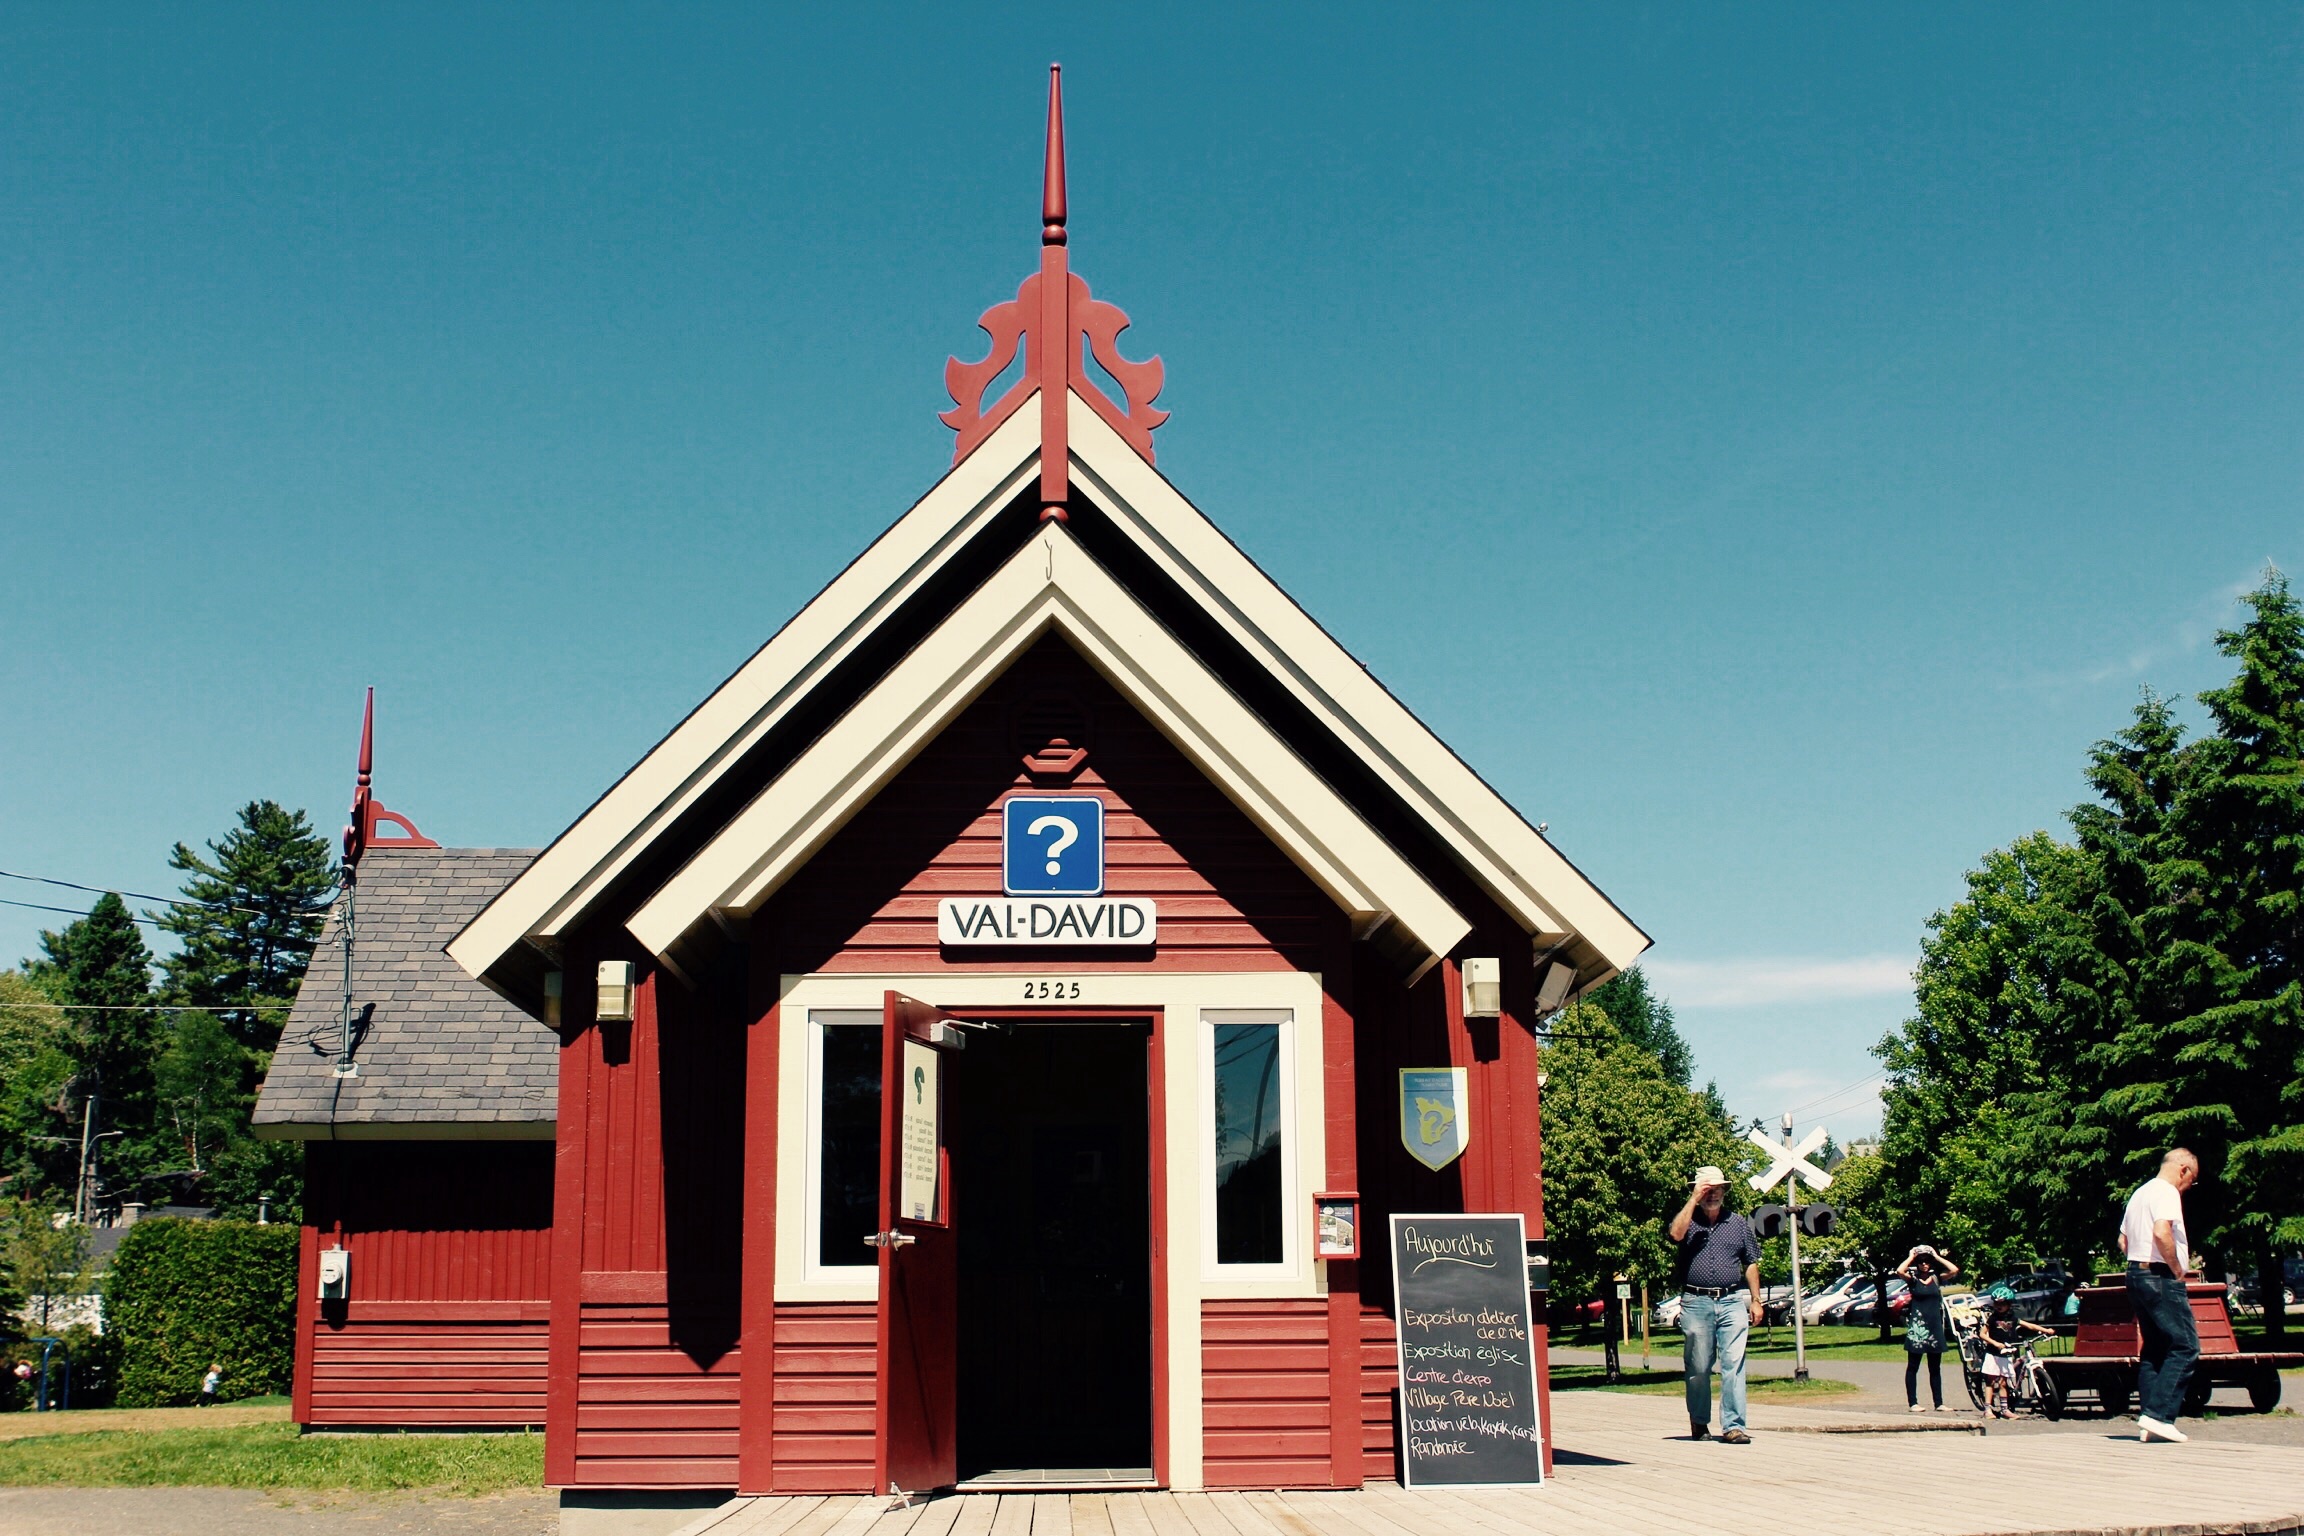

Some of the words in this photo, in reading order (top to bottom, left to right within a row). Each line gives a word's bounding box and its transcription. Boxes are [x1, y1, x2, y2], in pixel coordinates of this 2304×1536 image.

[949, 903, 1145, 939] VAL-DAVID
[1024, 982, 1081, 999] 2525
[1404, 1226, 1495, 1262] Aujourd'hui
[1403, 1341, 1471, 1362] Exposition
[1405, 1365, 1450, 1384] Centre
[1404, 1387, 1449, 1413] Village
[1483, 1391, 1515, 1409] Noël
